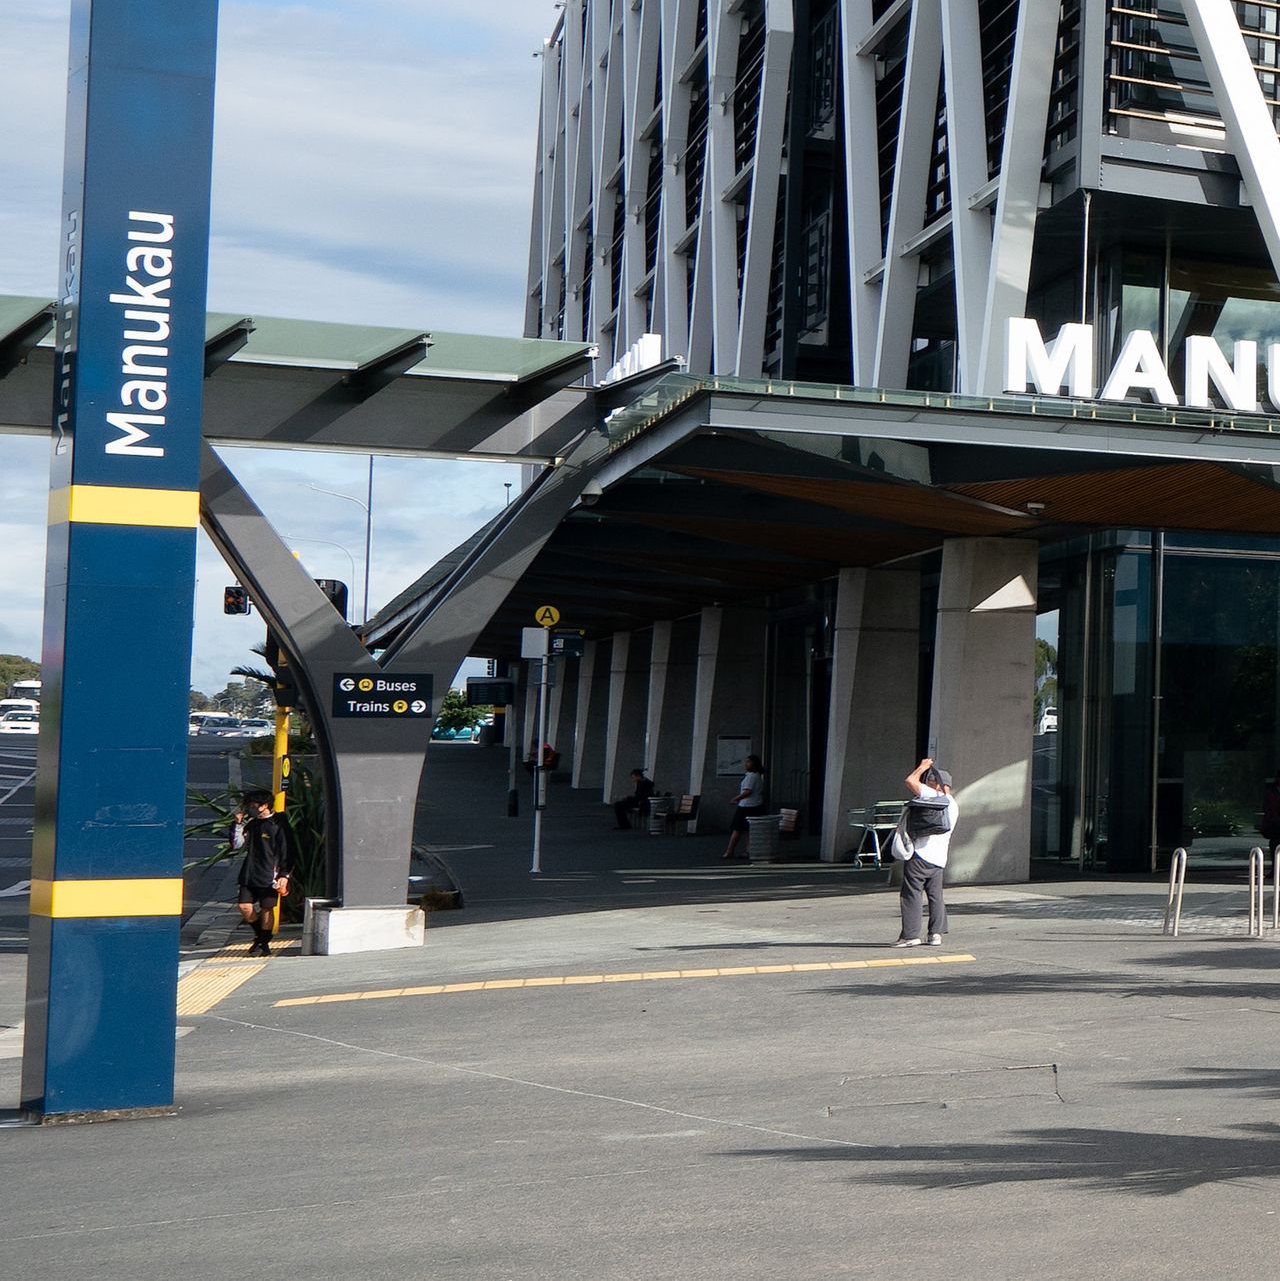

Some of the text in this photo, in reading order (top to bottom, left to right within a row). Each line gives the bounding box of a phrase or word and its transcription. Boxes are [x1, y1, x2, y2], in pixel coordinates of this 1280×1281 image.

[105, 210, 174, 457] Manukau
[539, 607, 556, 623] A
[376, 679, 417, 692] Buses
[347, 700, 390, 712] Trains
